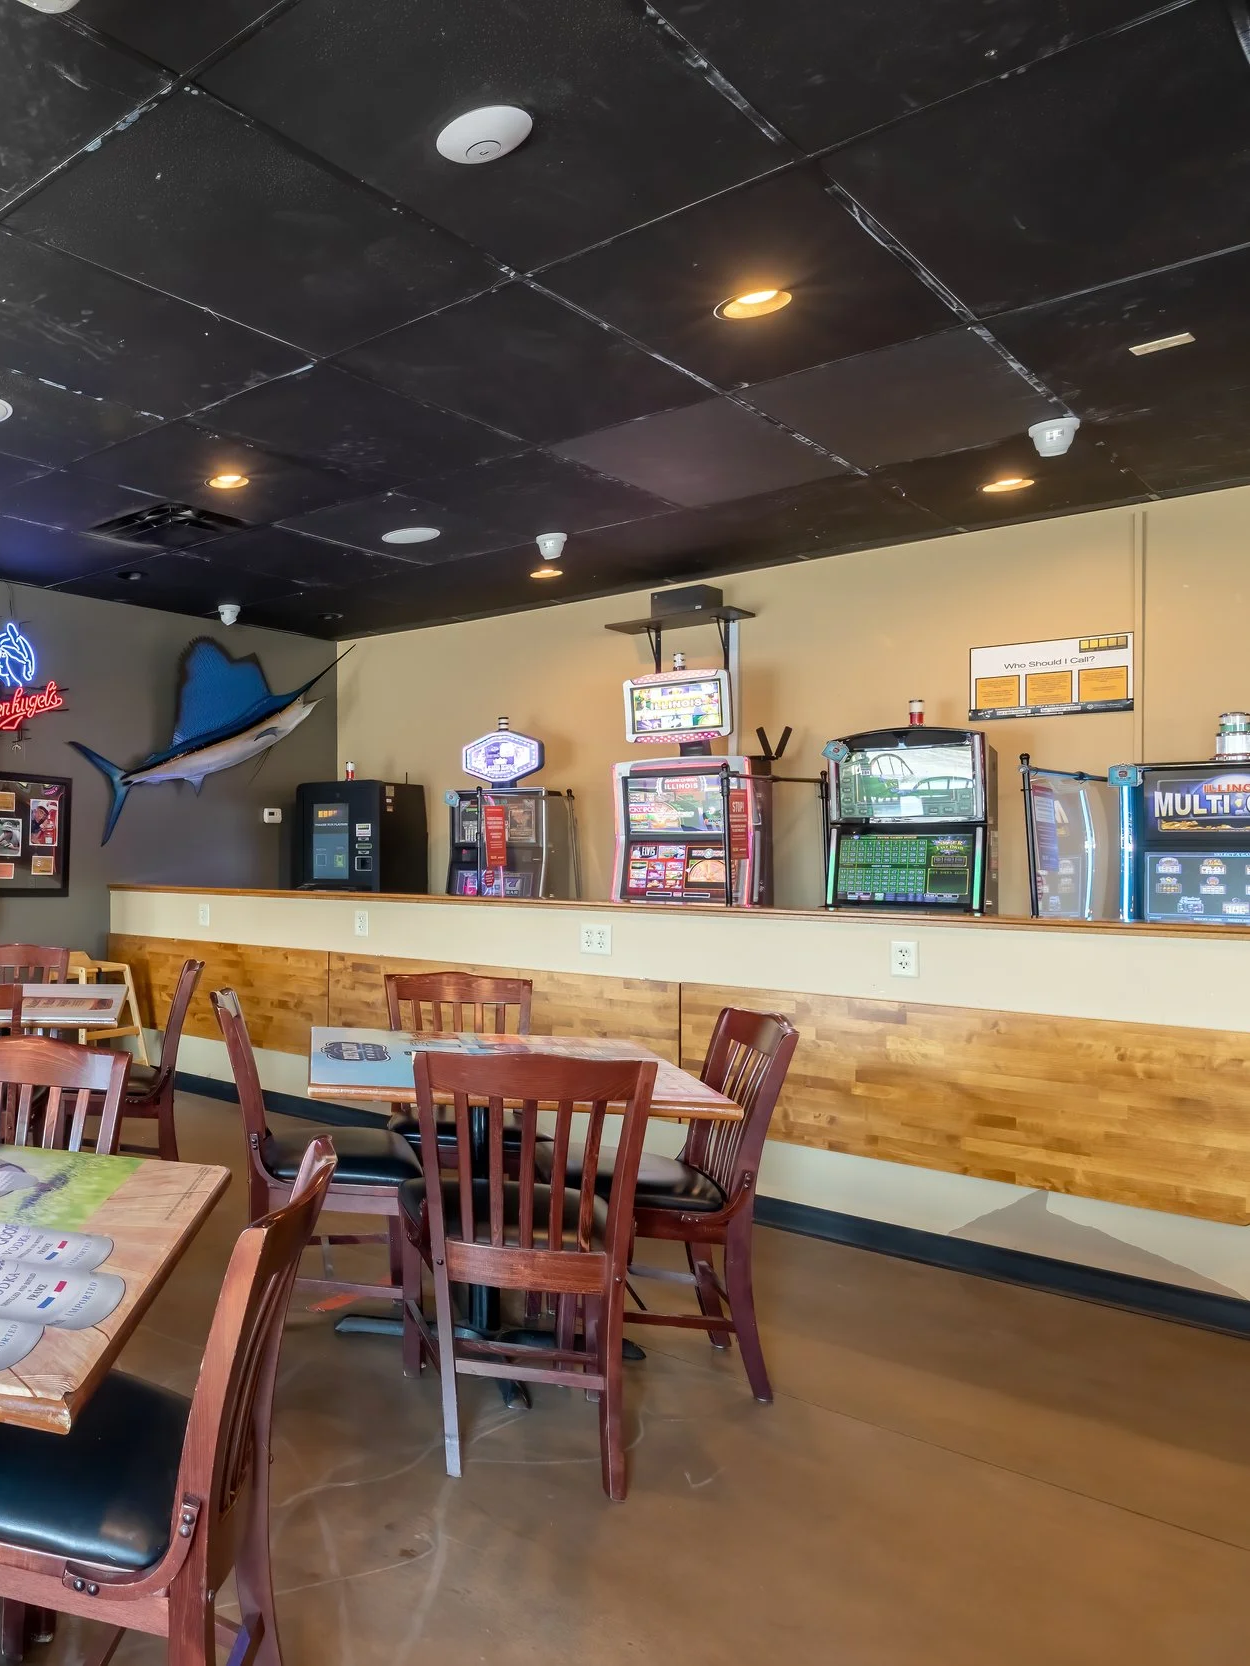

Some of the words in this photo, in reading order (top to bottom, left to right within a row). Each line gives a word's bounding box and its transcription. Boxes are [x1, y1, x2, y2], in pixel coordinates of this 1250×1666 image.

[1003, 661, 1027, 670] Who
[1028, 658, 1062, 668] Should
[1069, 655, 1096, 665] Call?
[650, 698, 703, 711] ILLINOIS
[664, 782, 699, 790] ILLINOIS
[732, 801, 745, 813] STOP!
[1154, 791, 1230, 818] MULTI
[642, 846, 656, 856] ELVIS
[2, 1235, 31, 1255] VODKA
[26, 1283, 48, 1301] FRANCE
[65, 1281, 98, 1317] IMPORTED
